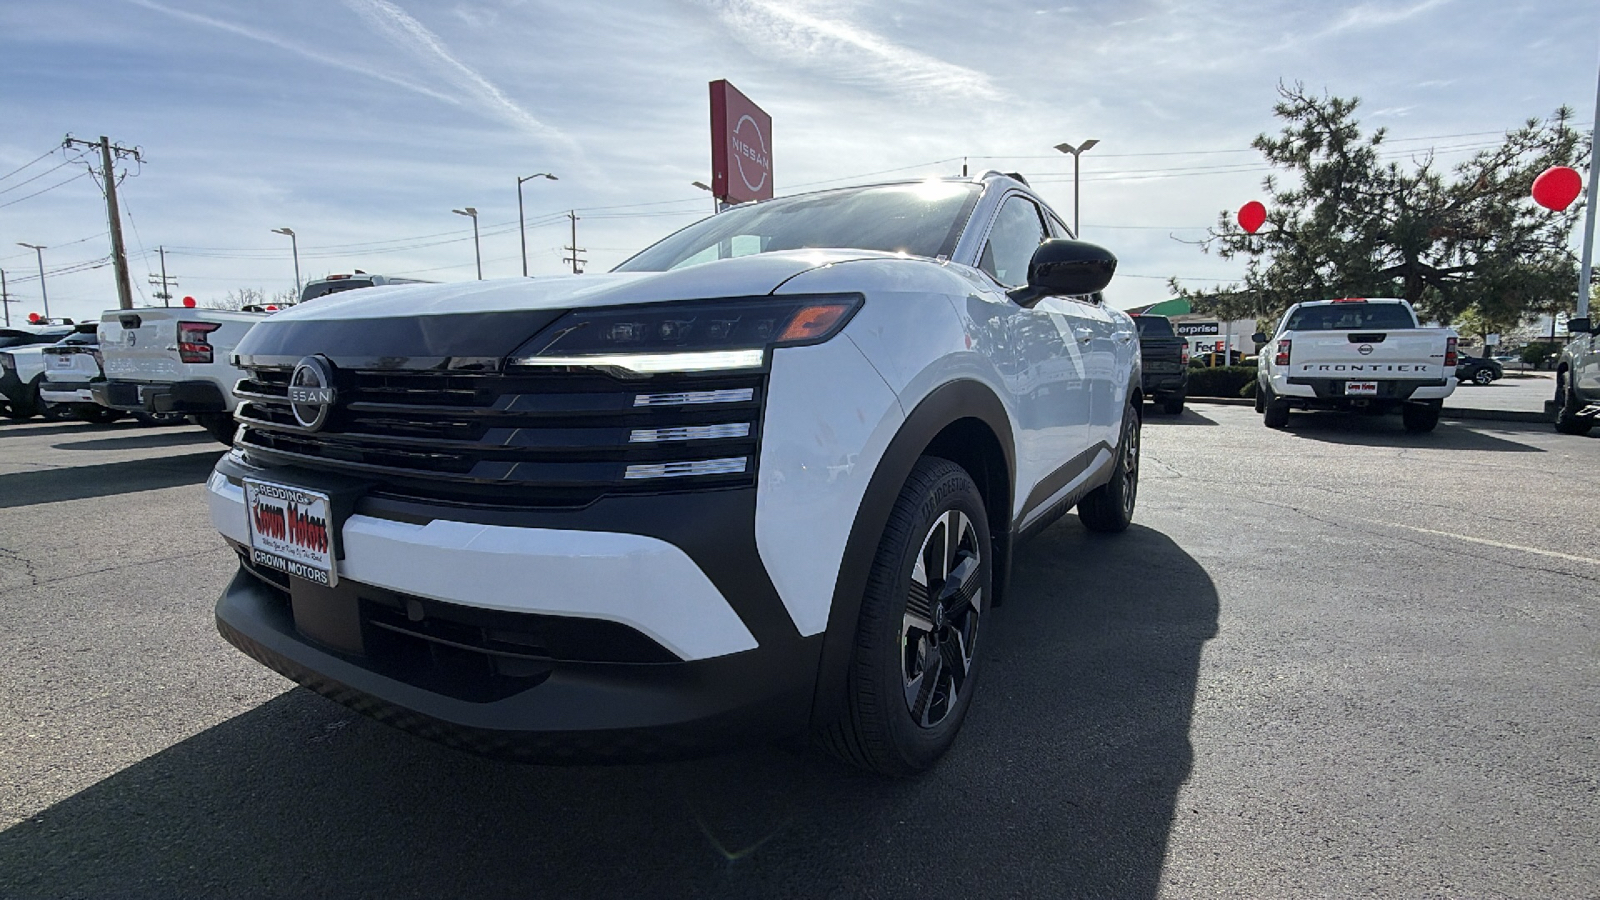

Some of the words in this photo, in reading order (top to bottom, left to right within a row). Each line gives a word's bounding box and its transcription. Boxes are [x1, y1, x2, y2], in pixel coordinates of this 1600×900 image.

[733, 136, 769, 170] NISSAN
[1178, 324, 1217, 334] erprise
[260, 484, 304, 503] REDDING
[921, 477, 971, 525] BRIDGESTONE
[287, 501, 329, 554] Motors
[254, 551, 287, 571] CROWN
[288, 561, 328, 583] MOTORS
